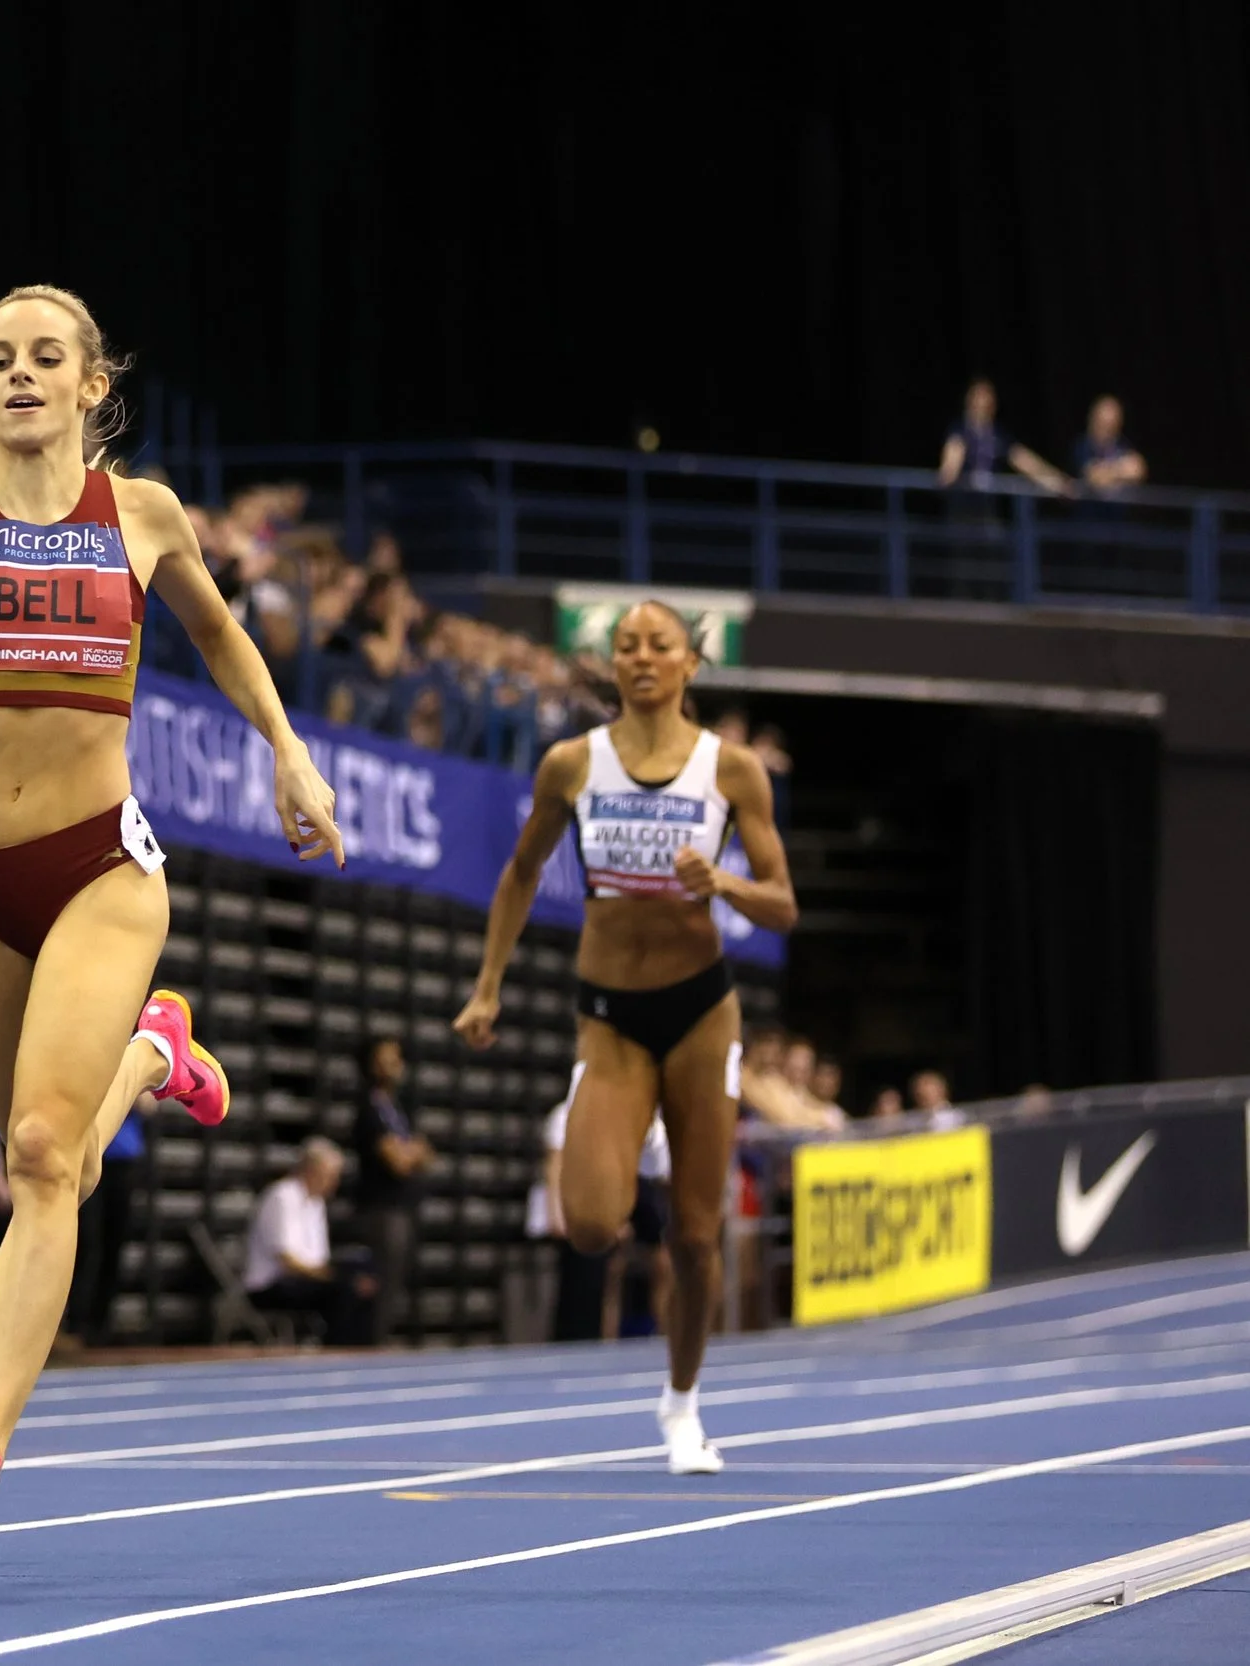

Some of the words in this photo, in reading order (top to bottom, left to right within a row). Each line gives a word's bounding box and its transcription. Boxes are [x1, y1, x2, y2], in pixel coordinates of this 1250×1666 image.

[4, 548, 66, 560] PROCESSING
[82, 653, 123, 664] INDOOR
[594, 825, 694, 847] WALCOTT
